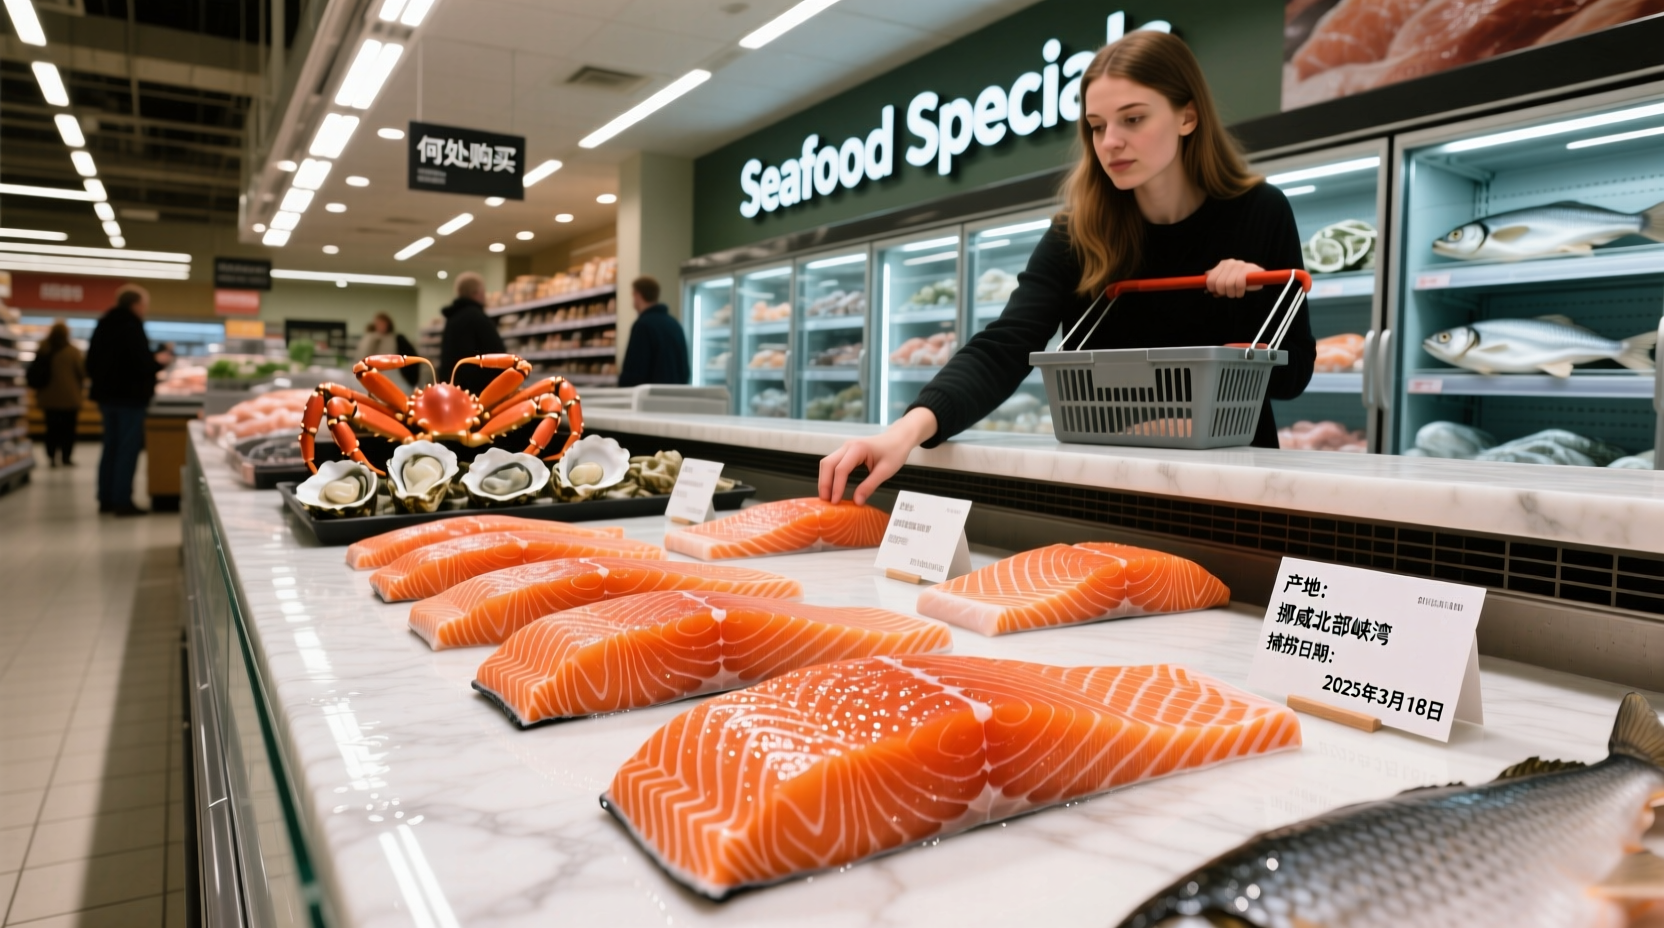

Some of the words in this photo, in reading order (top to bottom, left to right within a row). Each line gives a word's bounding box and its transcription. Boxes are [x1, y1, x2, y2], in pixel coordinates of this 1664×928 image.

[739, 104, 895, 219] Seafood
[906, 10, 1172, 176] Specia
[416, 134, 517, 174] 何处购买
[1276, 601, 1393, 647] 挪威北部峡湾
[1322, 674, 1445, 722] 2025年3月18日
